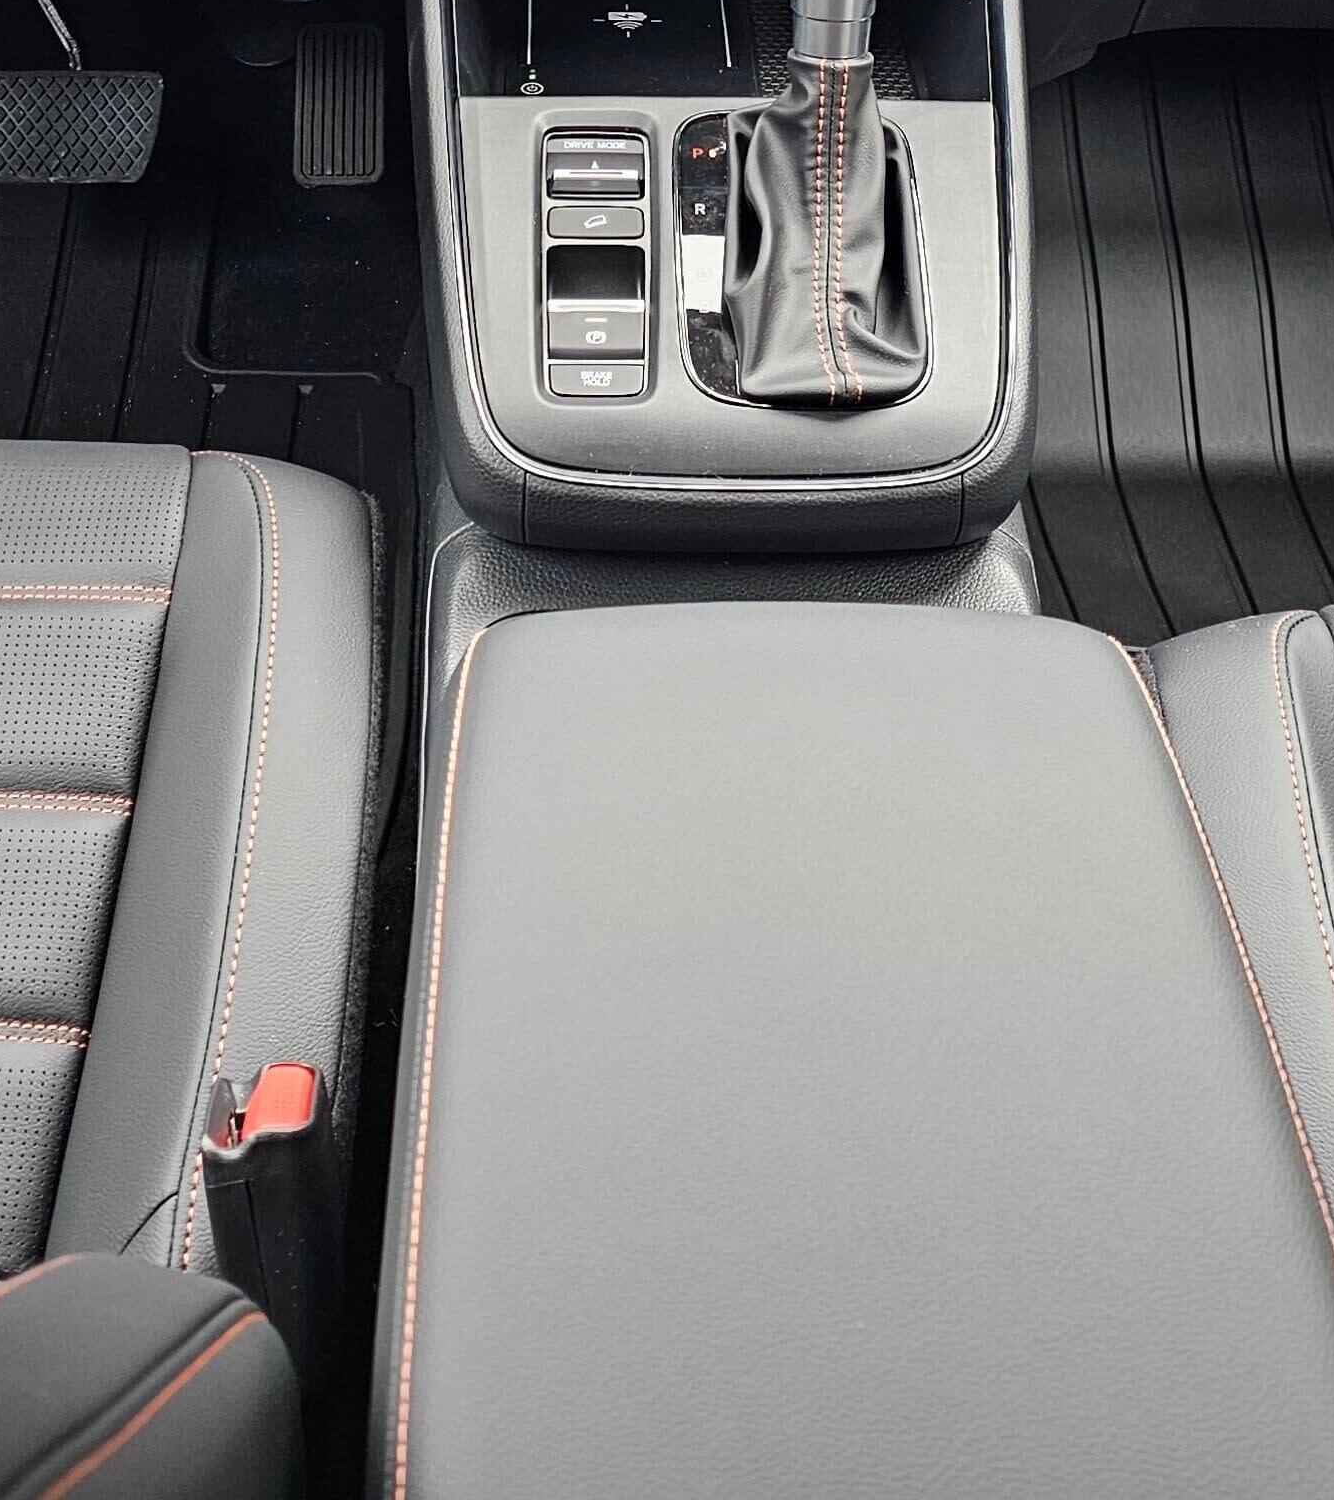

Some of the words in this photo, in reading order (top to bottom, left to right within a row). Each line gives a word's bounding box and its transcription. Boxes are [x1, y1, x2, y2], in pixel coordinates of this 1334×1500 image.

[563, 141, 594, 150] DRIVE
[597, 141, 627, 150] MODE
[692, 148, 704, 160] P
[694, 203, 706, 216] R
[580, 370, 613, 380] BRAKE
